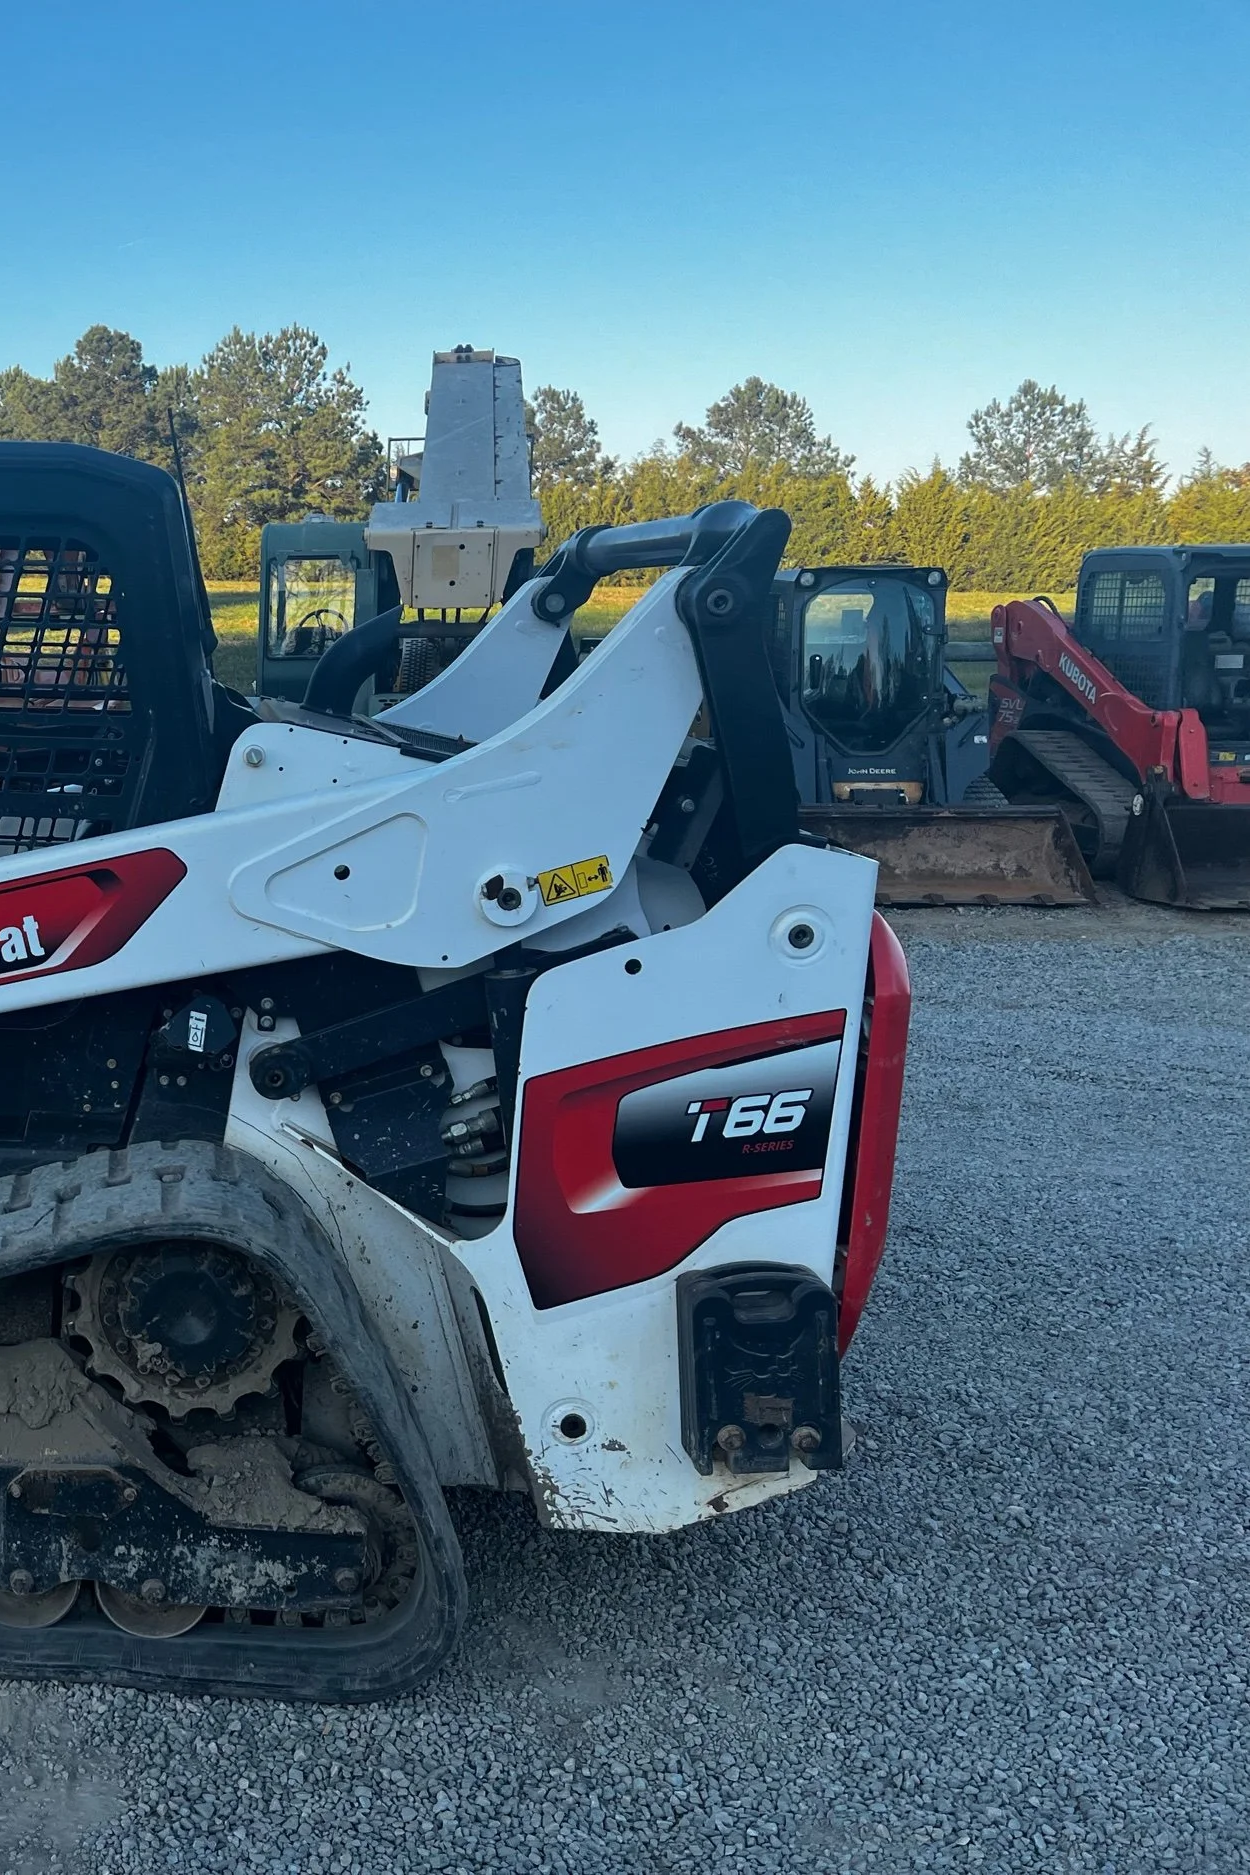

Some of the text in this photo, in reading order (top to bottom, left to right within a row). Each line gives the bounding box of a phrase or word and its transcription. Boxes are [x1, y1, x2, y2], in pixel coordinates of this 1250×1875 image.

[1058, 652, 1098, 704] KUBOTA
[1000, 698, 1023, 710] SVL
[687, 1087, 814, 1144] T66
[742, 1140, 795, 1155] R-SERIES
